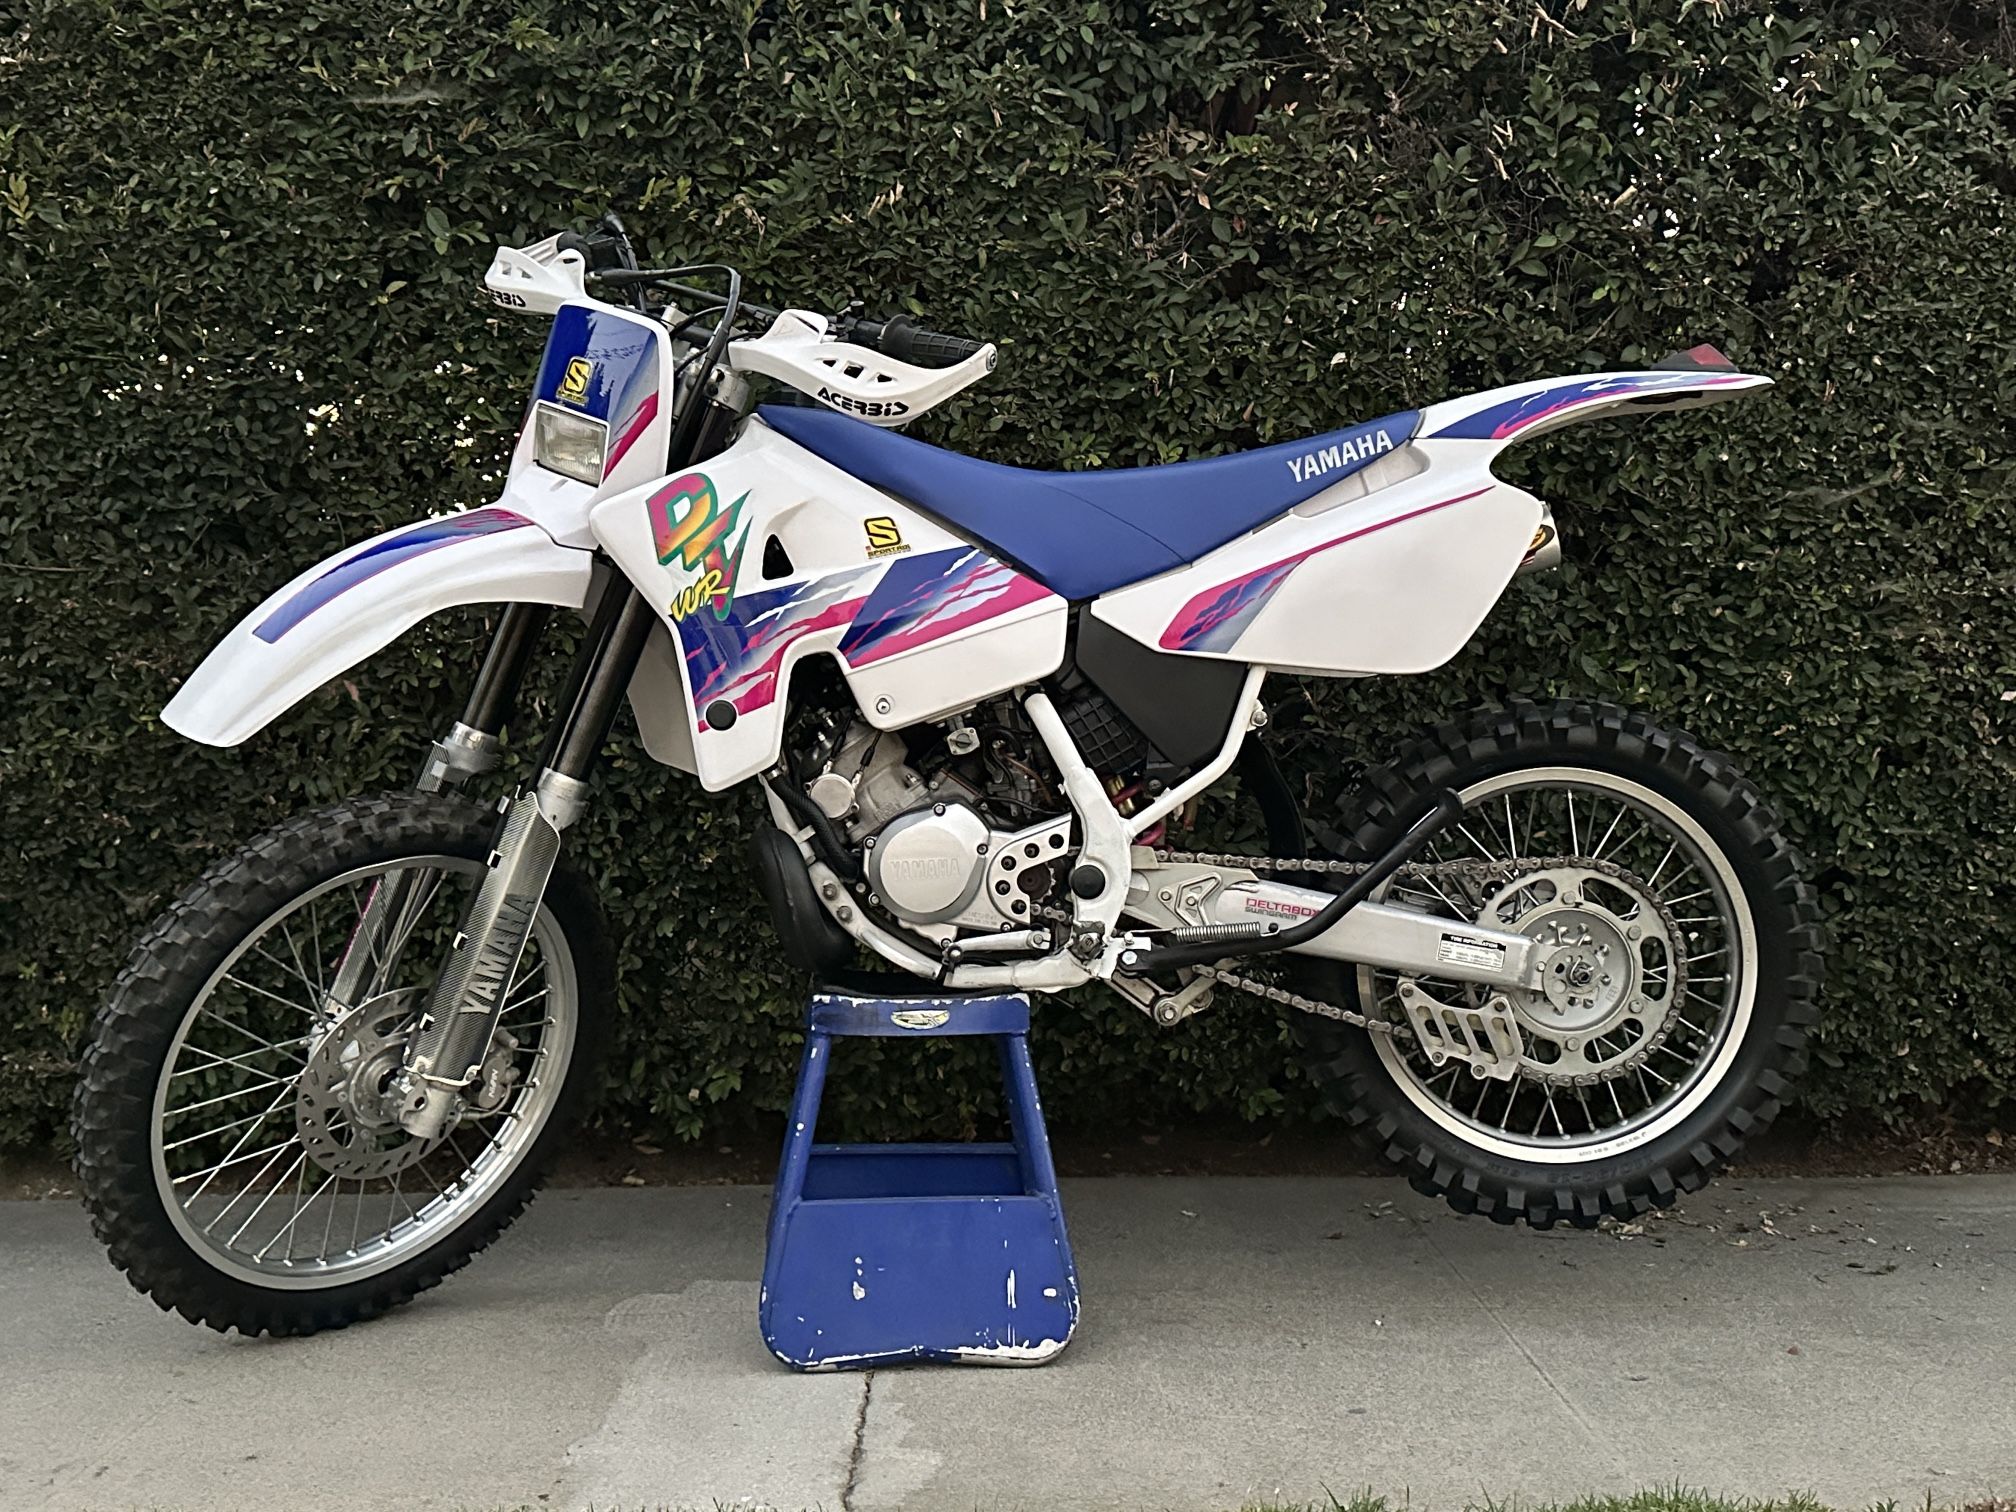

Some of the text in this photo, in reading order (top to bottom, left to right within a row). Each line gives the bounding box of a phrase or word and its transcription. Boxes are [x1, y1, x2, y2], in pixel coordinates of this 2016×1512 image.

[817, 386, 910, 417] ACERBIS
[1286, 429, 1394, 483] YAMAHA
[670, 568, 731, 623] WR
[890, 857, 960, 881] YAMAHA
[457, 893, 537, 1015] YAMAHA
